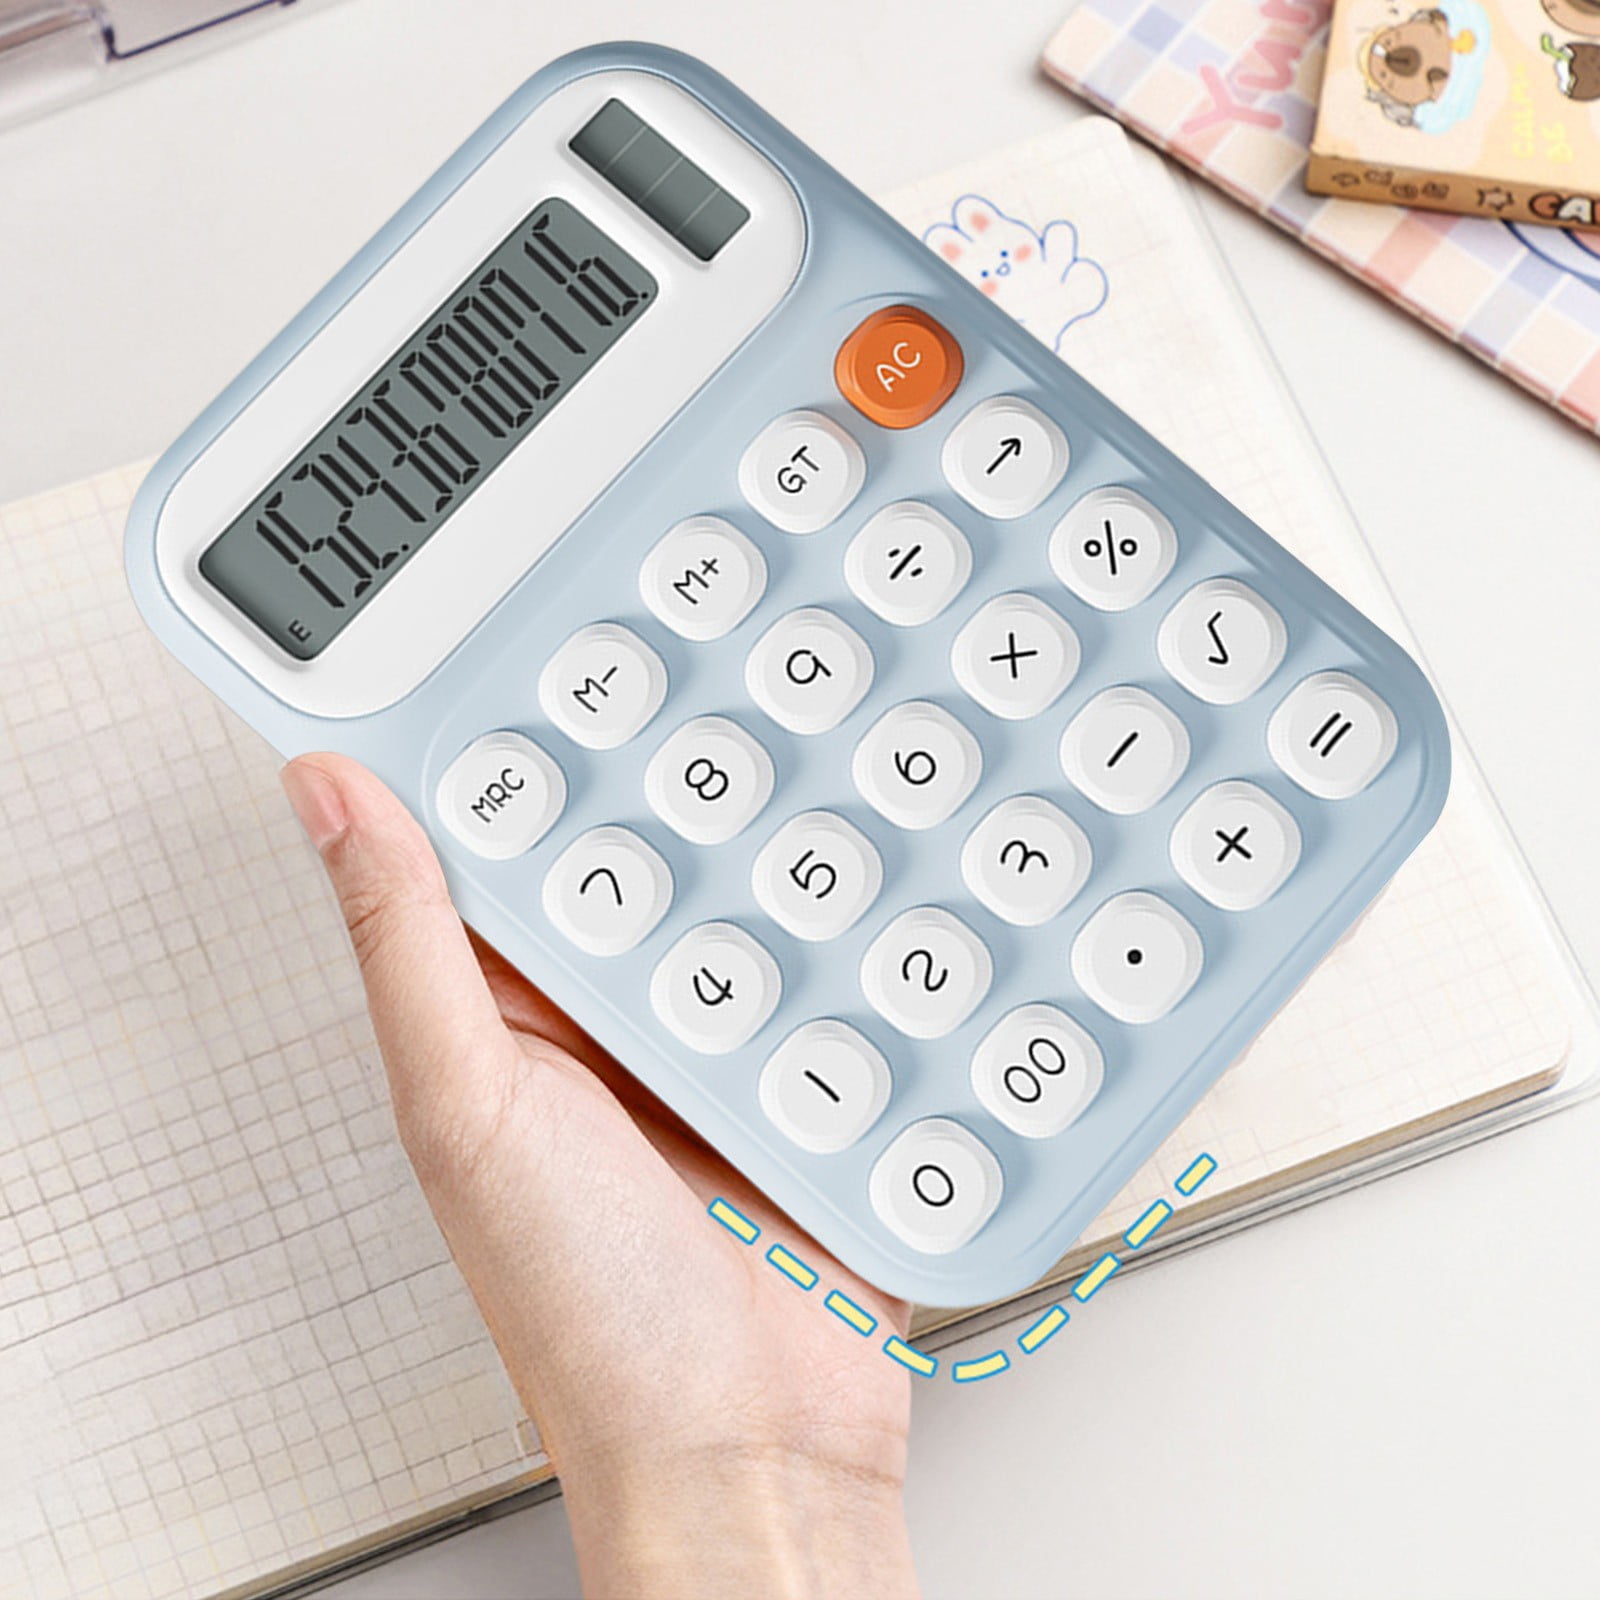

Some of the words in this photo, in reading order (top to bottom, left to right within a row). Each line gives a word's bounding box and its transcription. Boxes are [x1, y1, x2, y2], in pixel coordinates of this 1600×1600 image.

[1528, 192, 1600, 226] CA
[876, 342, 921, 393] AC
[777, 445, 820, 494] GT
[672, 558, 719, 605] M+
[287, 619, 312, 642] E
[785, 649, 832, 685] 9
[572, 666, 618, 713] M-
[684, 758, 729, 802] 8
[894, 750, 937, 786] 6
[470, 768, 525, 823] MRC
[789, 849, 837, 900] 5
[999, 839, 1049, 874] 3
[579, 867, 623, 906] 7
[692, 967, 734, 1007] 4
[901, 949, 948, 992] 2
[804, 1070, 841, 1103] 1
[1003, 1037, 1066, 1104] 00
[912, 1164, 955, 1208] 0
